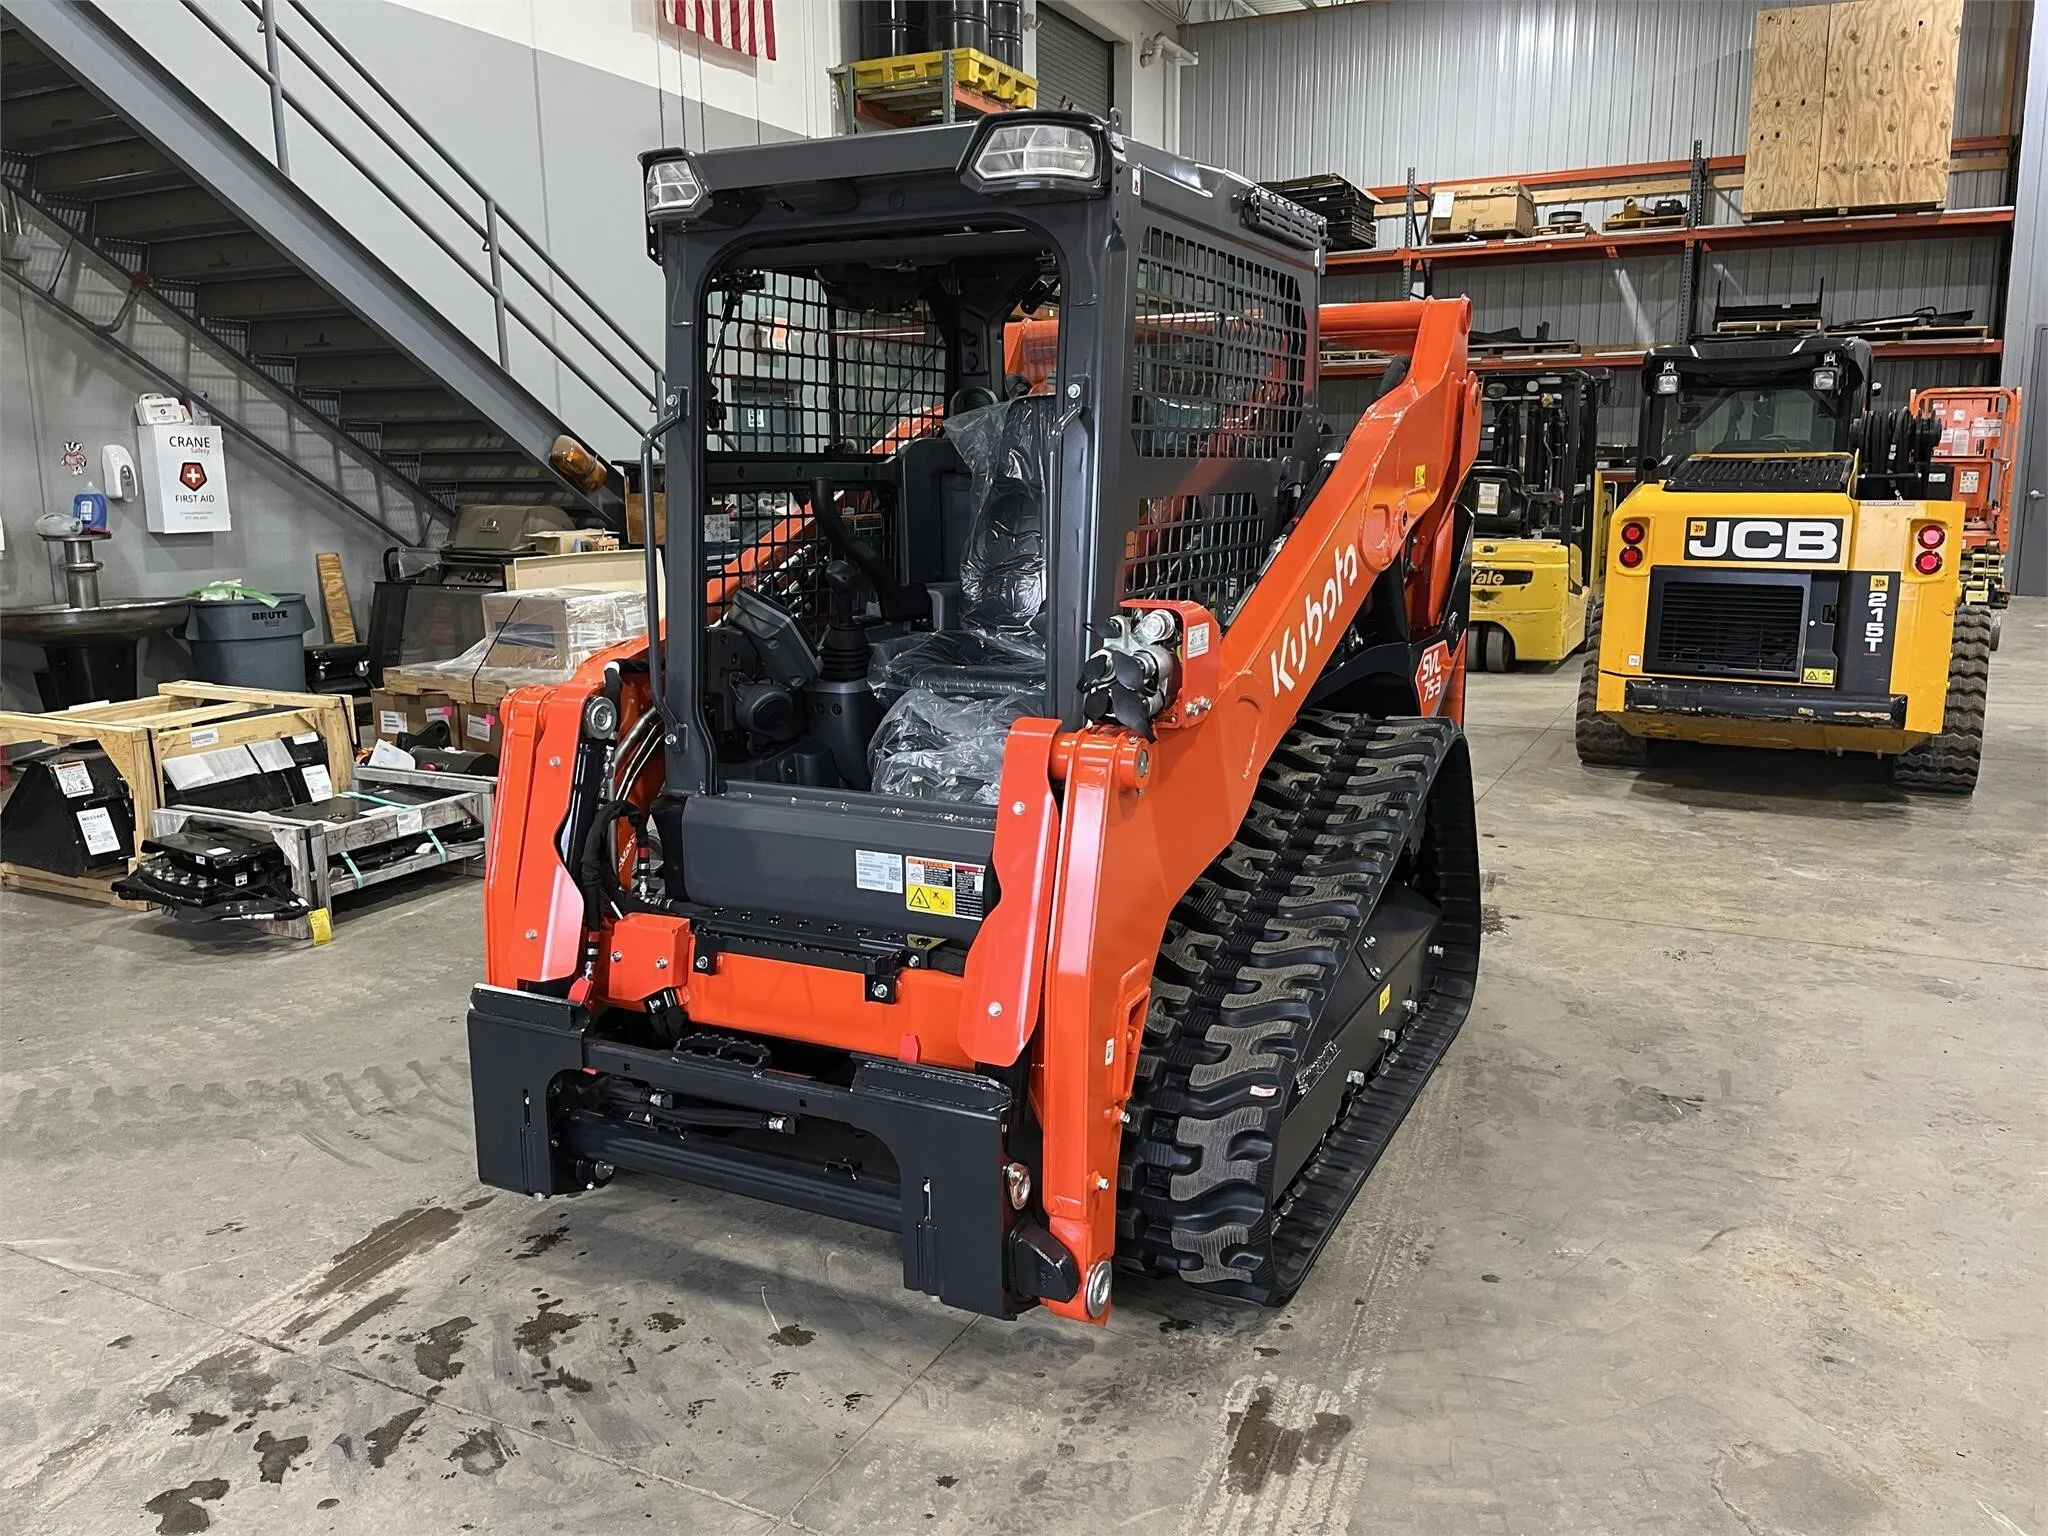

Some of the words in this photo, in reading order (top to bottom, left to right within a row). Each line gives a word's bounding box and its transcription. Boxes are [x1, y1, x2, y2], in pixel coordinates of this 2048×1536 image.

[169, 436, 211, 448] CRANE
[175, 494, 197, 503] FIRST
[200, 494, 215, 503] AID
[1688, 520, 1838, 560] JCB
[251, 610, 288, 620] BRUTE
[1270, 544, 1358, 697] Kubota
[1864, 592, 1887, 652] 215T
[1421, 648, 1442, 682] SVL
